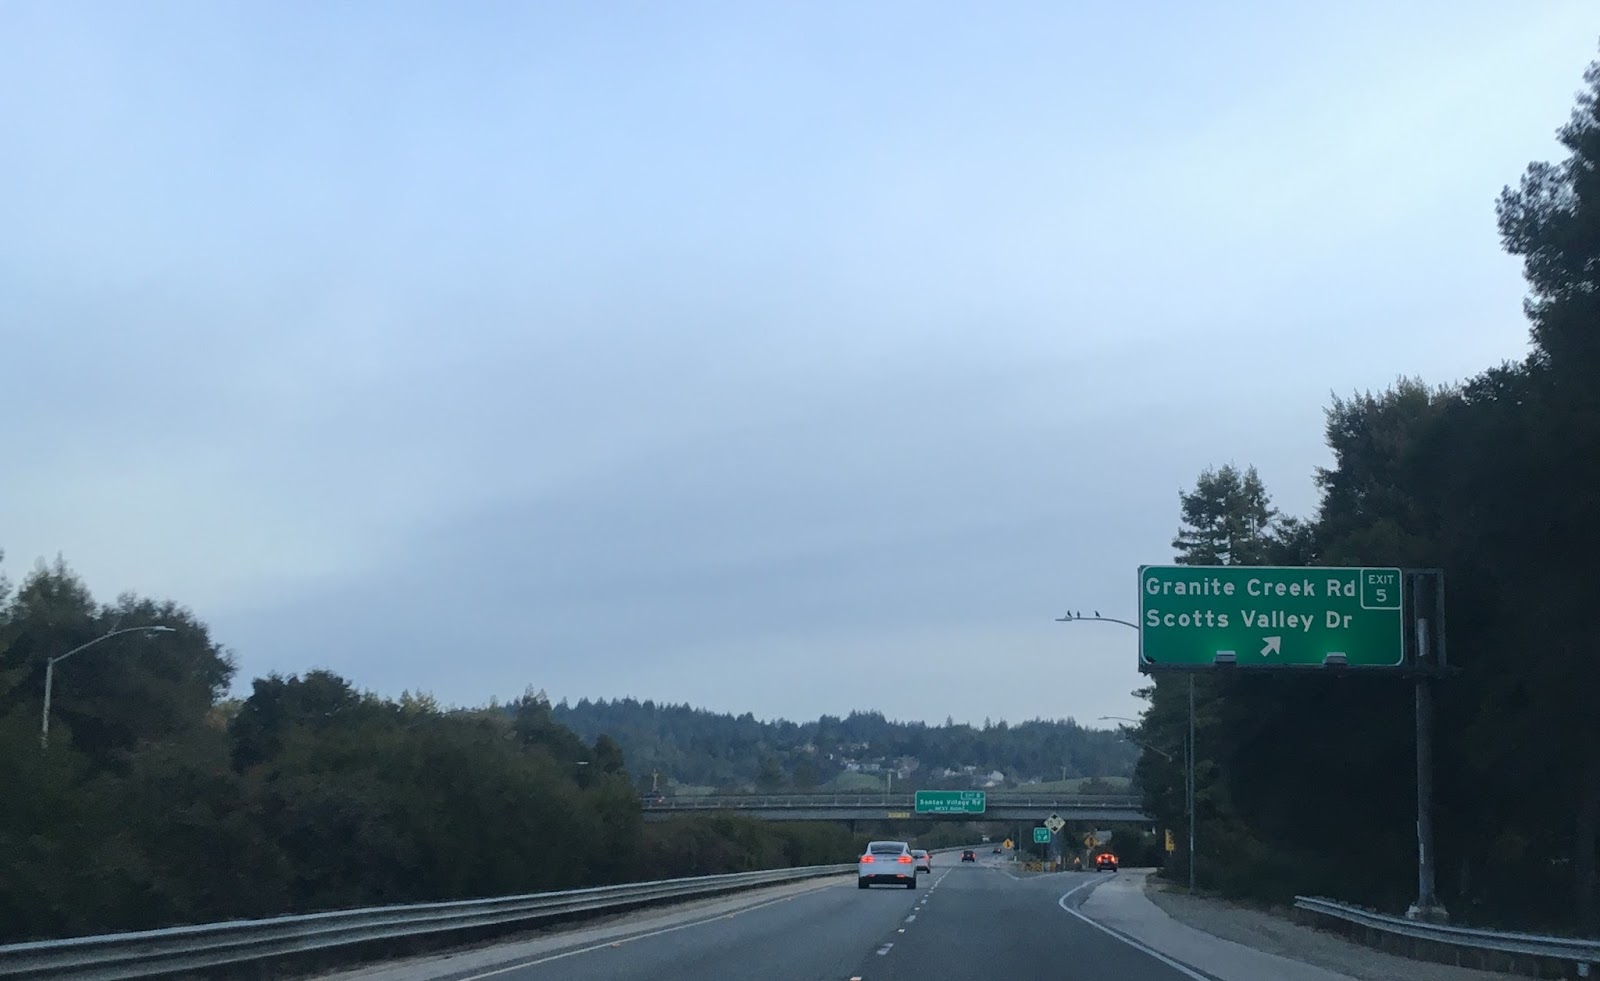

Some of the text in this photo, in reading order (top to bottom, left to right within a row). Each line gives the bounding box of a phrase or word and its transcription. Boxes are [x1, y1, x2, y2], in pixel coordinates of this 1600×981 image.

[1145, 577, 1356, 597] Granite Creek Rd
[1368, 574, 1395, 585] EXIT
[1376, 588, 1387, 602] 5
[1145, 609, 1353, 632] Scotts Valley Dr
